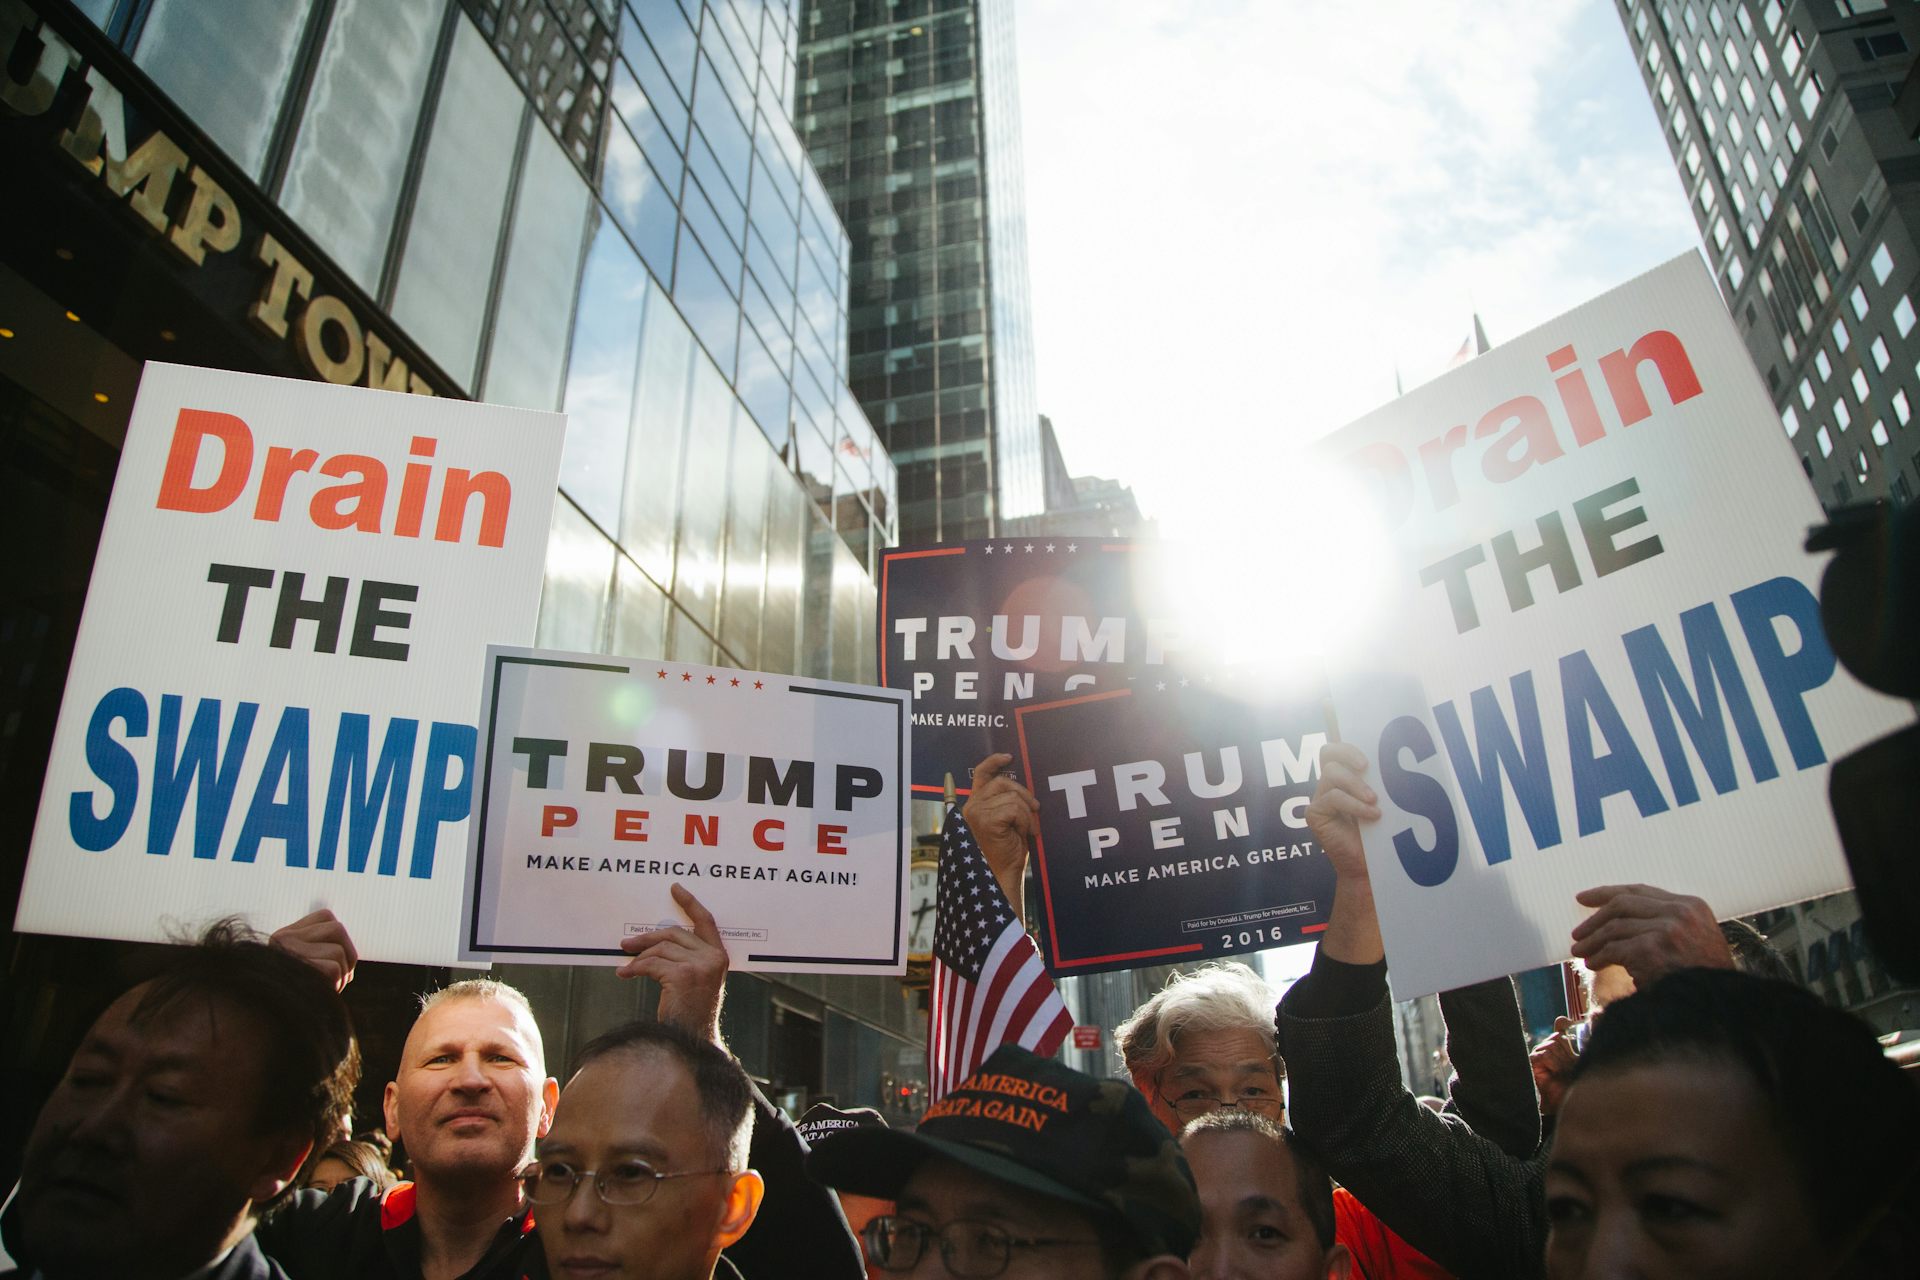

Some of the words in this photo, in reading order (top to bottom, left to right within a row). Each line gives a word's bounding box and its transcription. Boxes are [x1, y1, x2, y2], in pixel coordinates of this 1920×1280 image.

[248, 233, 438, 396] TOW
[156, 408, 512, 549] Drain
[1418, 476, 1665, 635] THE
[206, 563, 420, 662] THE
[894, 614, 1188, 665] TRUMP
[910, 713, 943, 726] MAKE
[947, 713, 1009, 728] AMERIC
[1377, 575, 1837, 888] SWAMP
[69, 686, 478, 880] SWAMP
[512, 736, 884, 812] TRUMP
[541, 805, 849, 856] PENCE
[526, 854, 590, 871] MAKE
[598, 858, 701, 877] AMERICA
[709, 864, 778, 881] GREAT
[785, 869, 857, 886] AGAIN!
[1084, 869, 1140, 889] MAKE
[1147, 854, 1240, 880] AMERICA
[1247, 841, 1313, 865] GREAT
[1187, 921, 1200, 929] Paid
[1217, 915, 1238, 925] Donald
[1243, 912, 1262, 921] Trump
[1221, 926, 1282, 949] 2016
[961, 1072, 1069, 1113] AMERICA
[965, 1100, 1048, 1132] AGAIN
[808, 1119, 860, 1132] AMERICA
